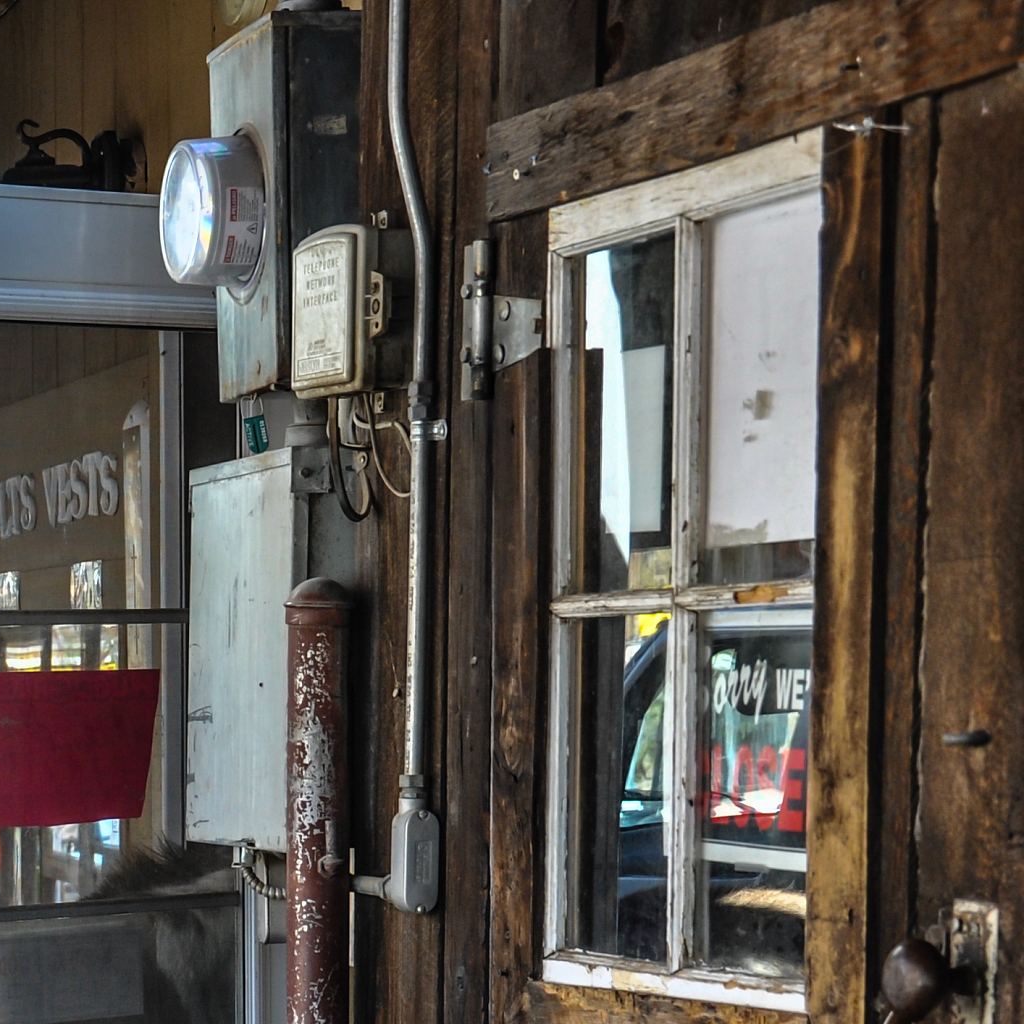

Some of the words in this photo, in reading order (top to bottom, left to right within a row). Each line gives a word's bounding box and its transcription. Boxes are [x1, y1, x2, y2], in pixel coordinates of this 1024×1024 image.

[303, 257, 340, 275] TELEPHONE
[306, 275, 335, 291] NETWORK
[303, 291, 338, 309] INTERFACE
[42, 451, 119, 528] VESTS
